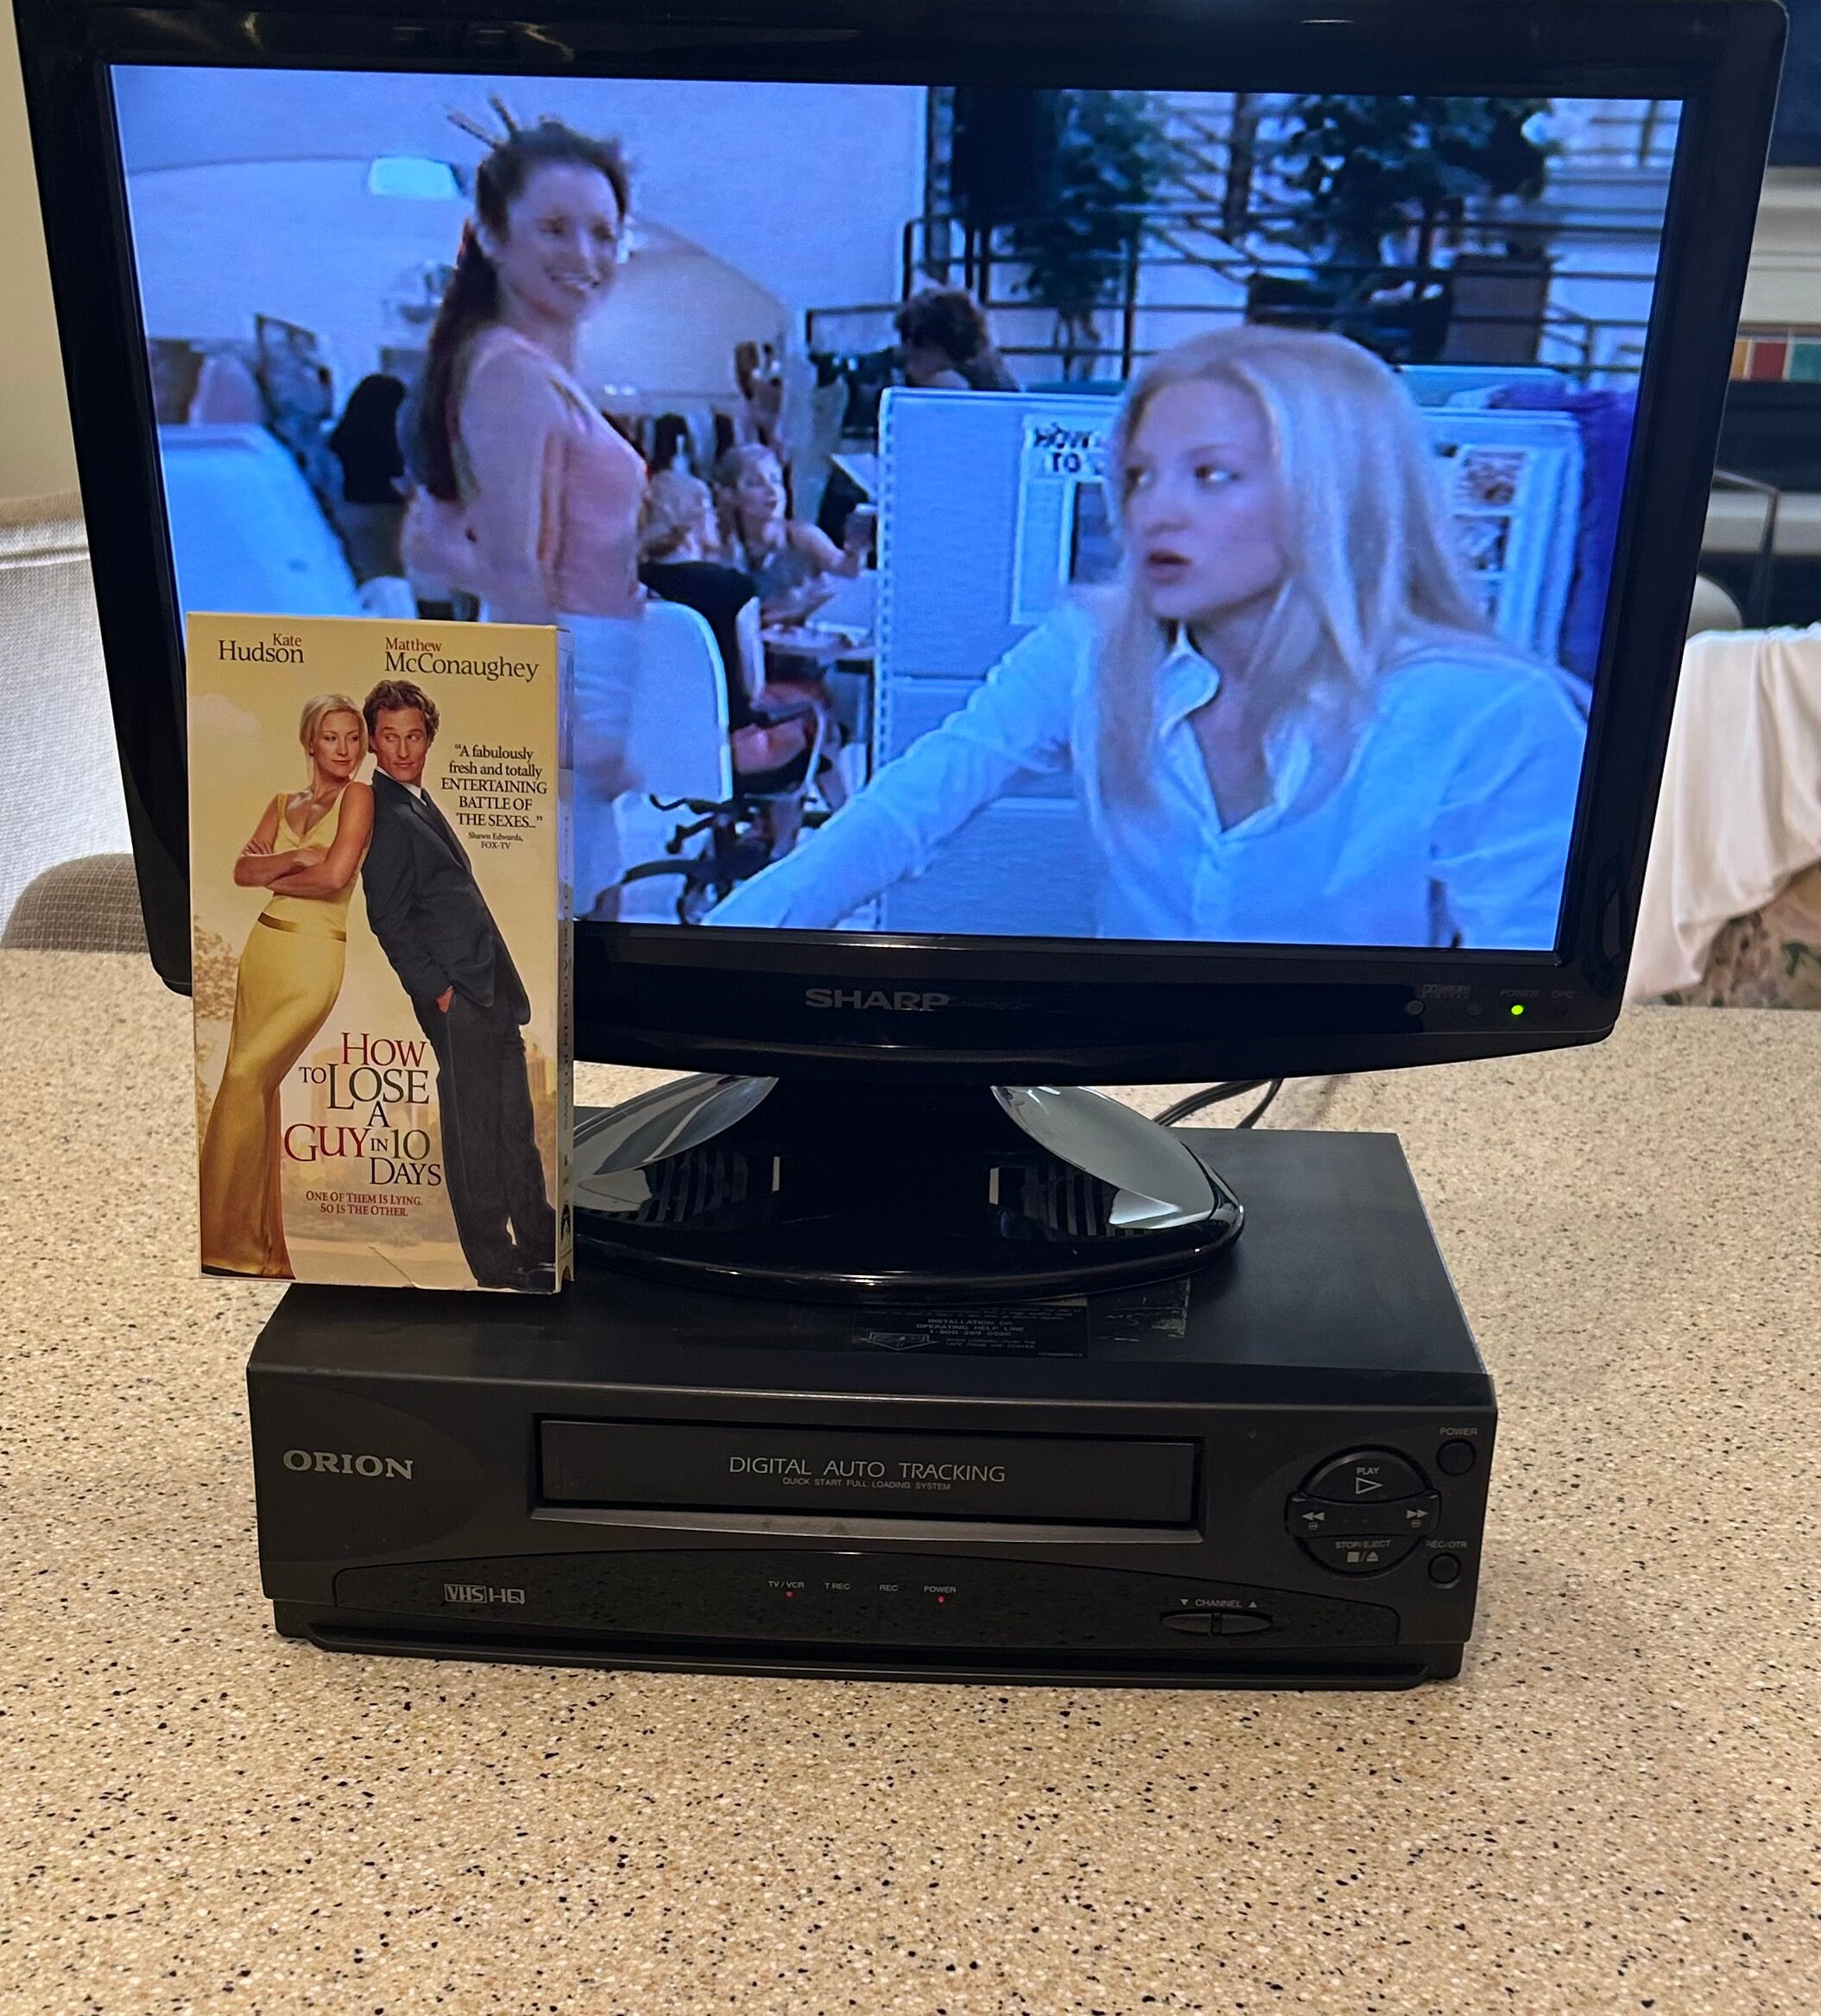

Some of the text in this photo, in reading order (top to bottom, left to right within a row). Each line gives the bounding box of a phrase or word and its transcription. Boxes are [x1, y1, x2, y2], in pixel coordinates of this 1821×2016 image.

[272, 633, 302, 647] Kate
[385, 637, 442, 652] Matthew
[218, 640, 305, 663] Hudson
[385, 651, 540, 683] McConaughey
[472, 744, 534, 763] fabulously
[449, 760, 543, 780] fresh and totally
[441, 777, 547, 794] ENTERTAINING
[459, 795, 533, 811] BATTLE OF
[456, 812, 486, 826] THE
[806, 988, 950, 1011] SHARP
[341, 1032, 427, 1067] HOW
[299, 1064, 430, 1109] TO LOSE
[366, 1100, 391, 1128] A
[284, 1123, 430, 1162] GUY IN 10
[369, 1157, 442, 1185] DAYS
[306, 1191, 423, 1205] ONE OF THEM IS LYING.
[320, 1204, 408, 1217] SO IS THE OTHER.
[1439, 1427, 1477, 1437] POWER
[282, 1450, 414, 1480] ORION
[730, 1457, 1006, 1482] DIGITAL AUTO TRACKING
[1356, 1466, 1380, 1476] PLAY
[782, 1476, 951, 1490] QUICK START FULL LOADING SYSTEM
[1335, 1539, 1392, 1550] STOP/EJECT
[1426, 1540, 1467, 1549] REC/OTR
[446, 1585, 486, 1602] VHS
[879, 1583, 899, 1592] REC
[924, 1585, 956, 1594] POWER
[1195, 1598, 1242, 1608] CHANNEL
